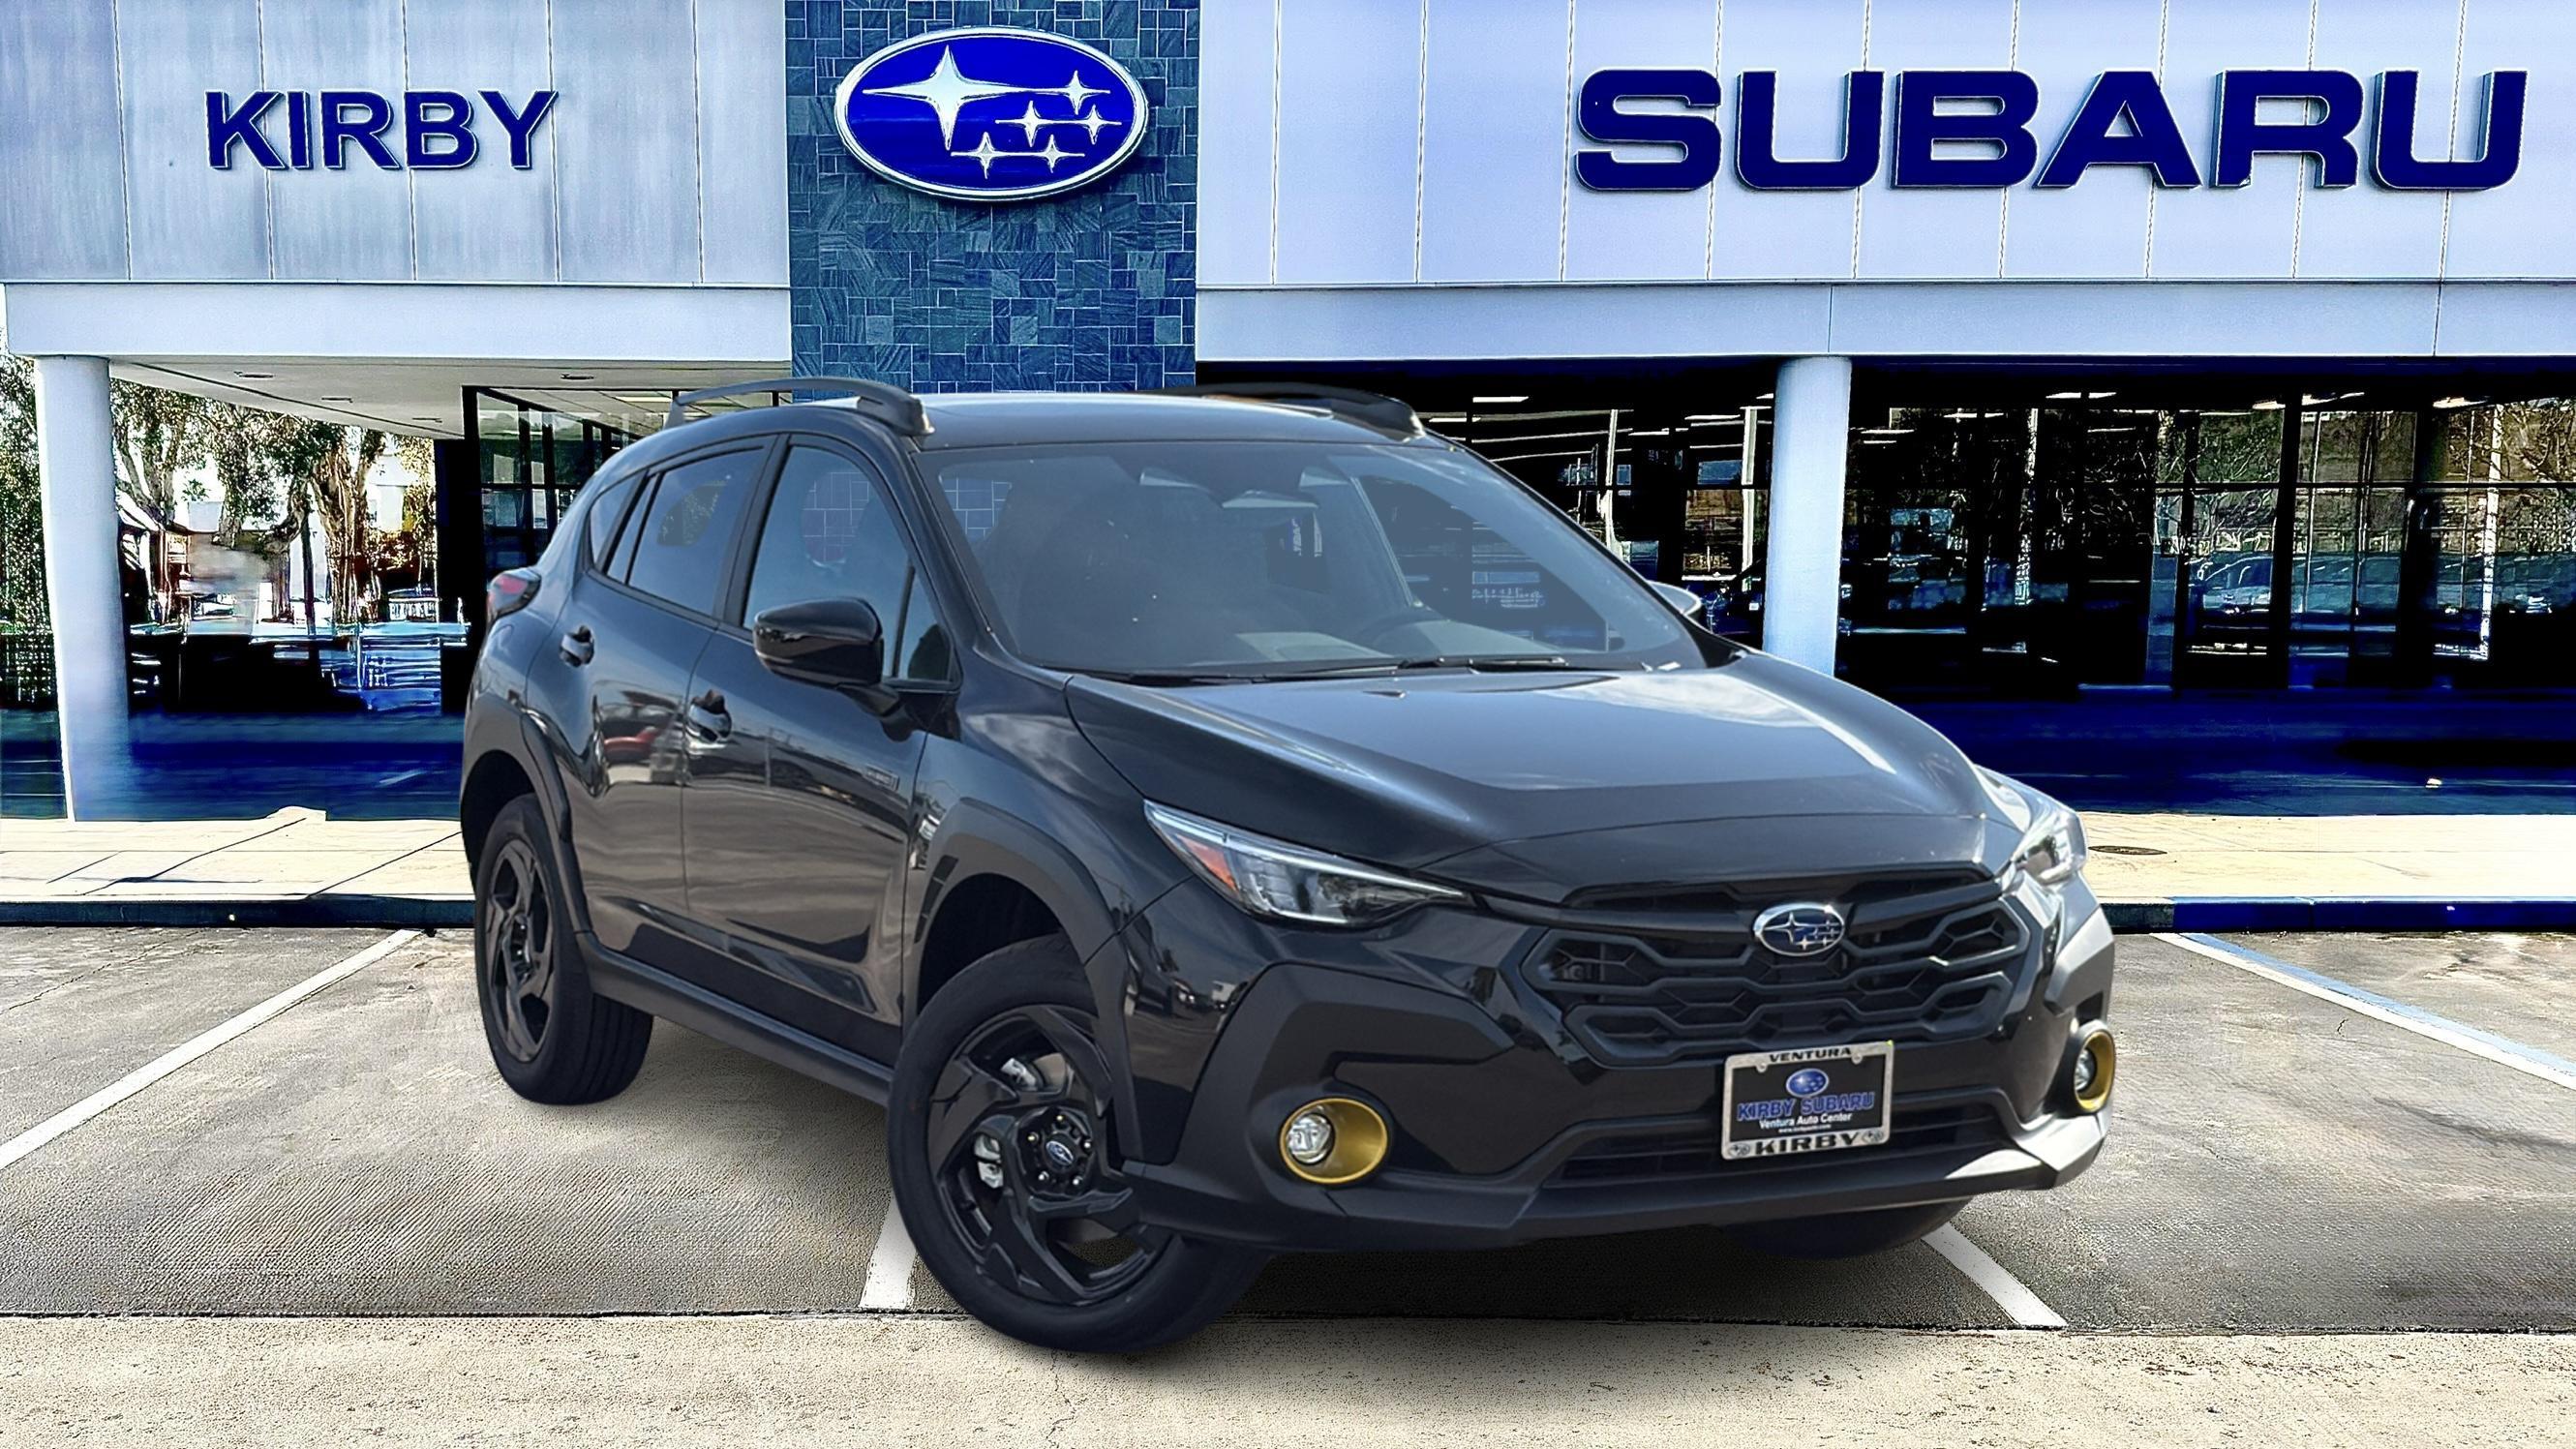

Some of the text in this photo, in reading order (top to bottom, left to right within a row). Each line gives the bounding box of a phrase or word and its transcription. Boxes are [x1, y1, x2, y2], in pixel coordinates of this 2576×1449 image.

[205, 90, 559, 170] KIRBY
[1575, 69, 2529, 192] SUBARU
[1769, 1047, 1852, 1063] VENTURA
[1737, 1092, 1875, 1122] KIRBY SUBARU
[1759, 1117, 1795, 1130] Ventura
[1797, 1114, 1820, 1126] Auto
[1820, 1112, 1853, 1124] Center
[1755, 1132, 1860, 1155] KIRBY
